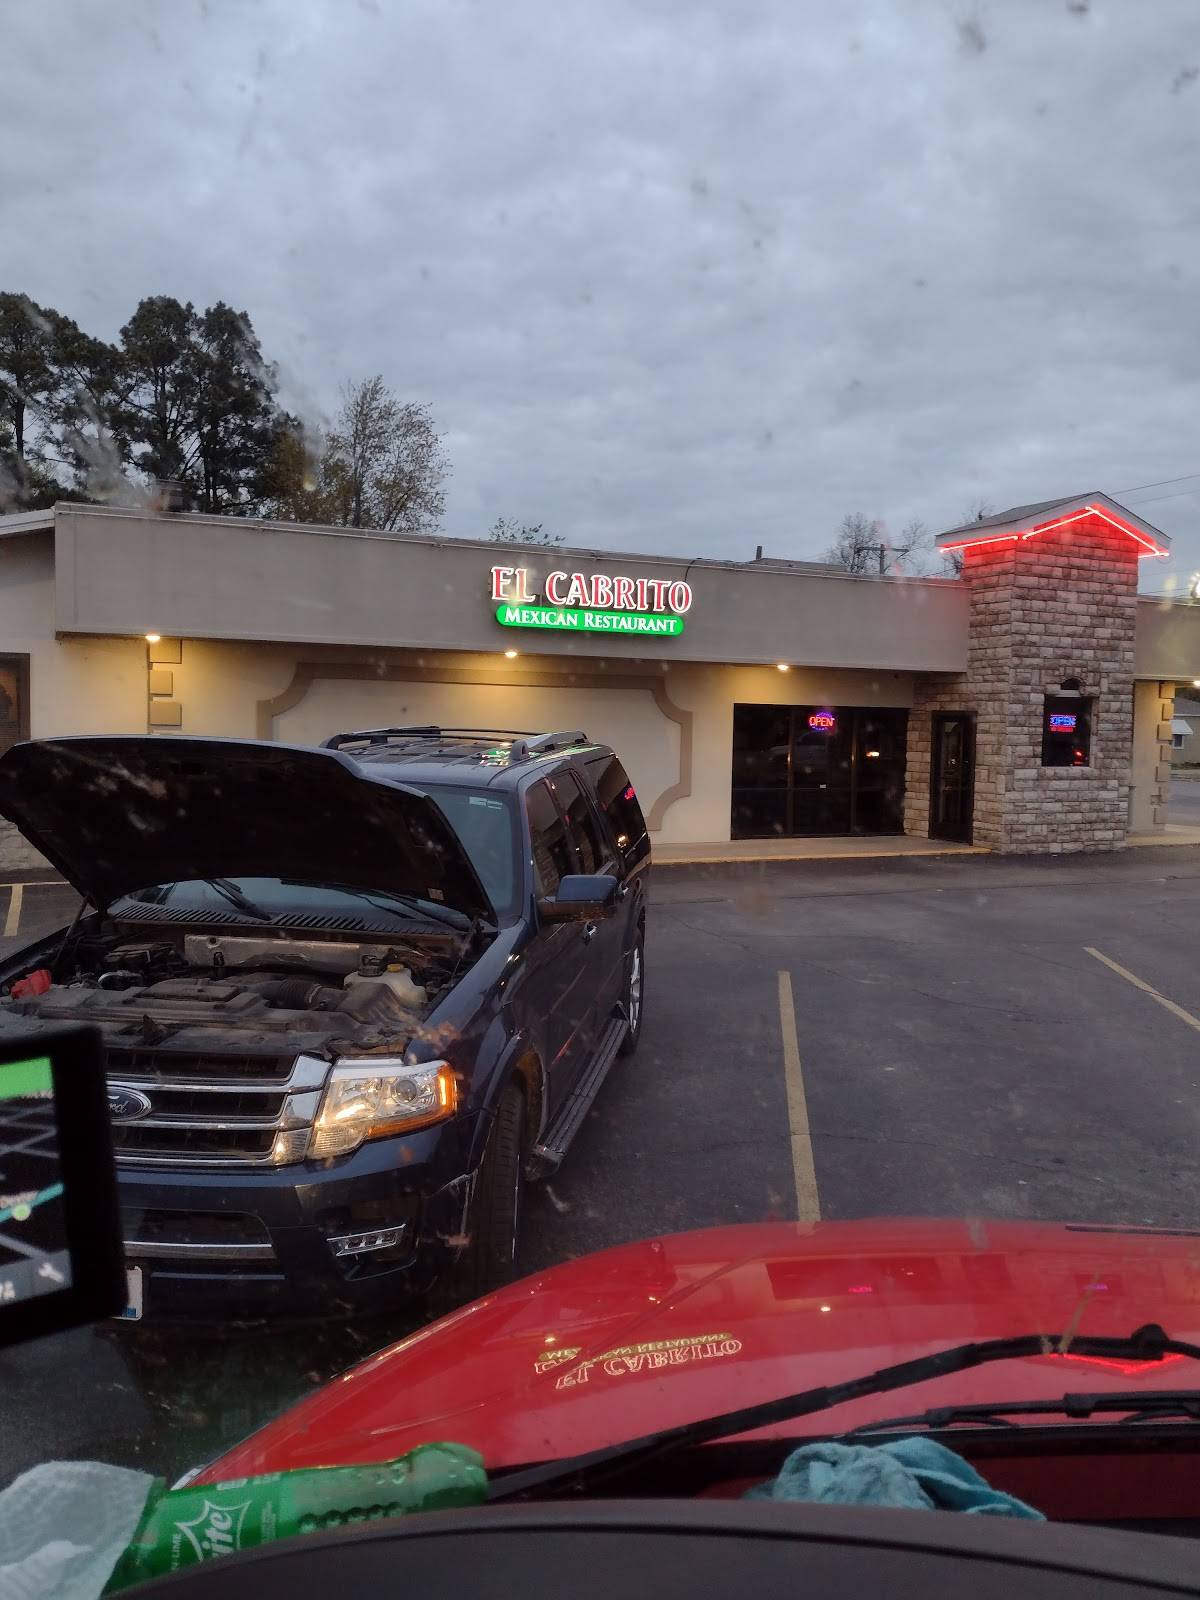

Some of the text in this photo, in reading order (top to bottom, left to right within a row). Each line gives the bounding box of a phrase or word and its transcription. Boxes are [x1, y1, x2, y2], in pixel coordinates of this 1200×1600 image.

[490, 566, 693, 614] EL CABRITO
[504, 607, 677, 633] MEXICAN RESTAURANT
[809, 716, 834, 727] OPEN
[205, 1512, 234, 1558] ite
